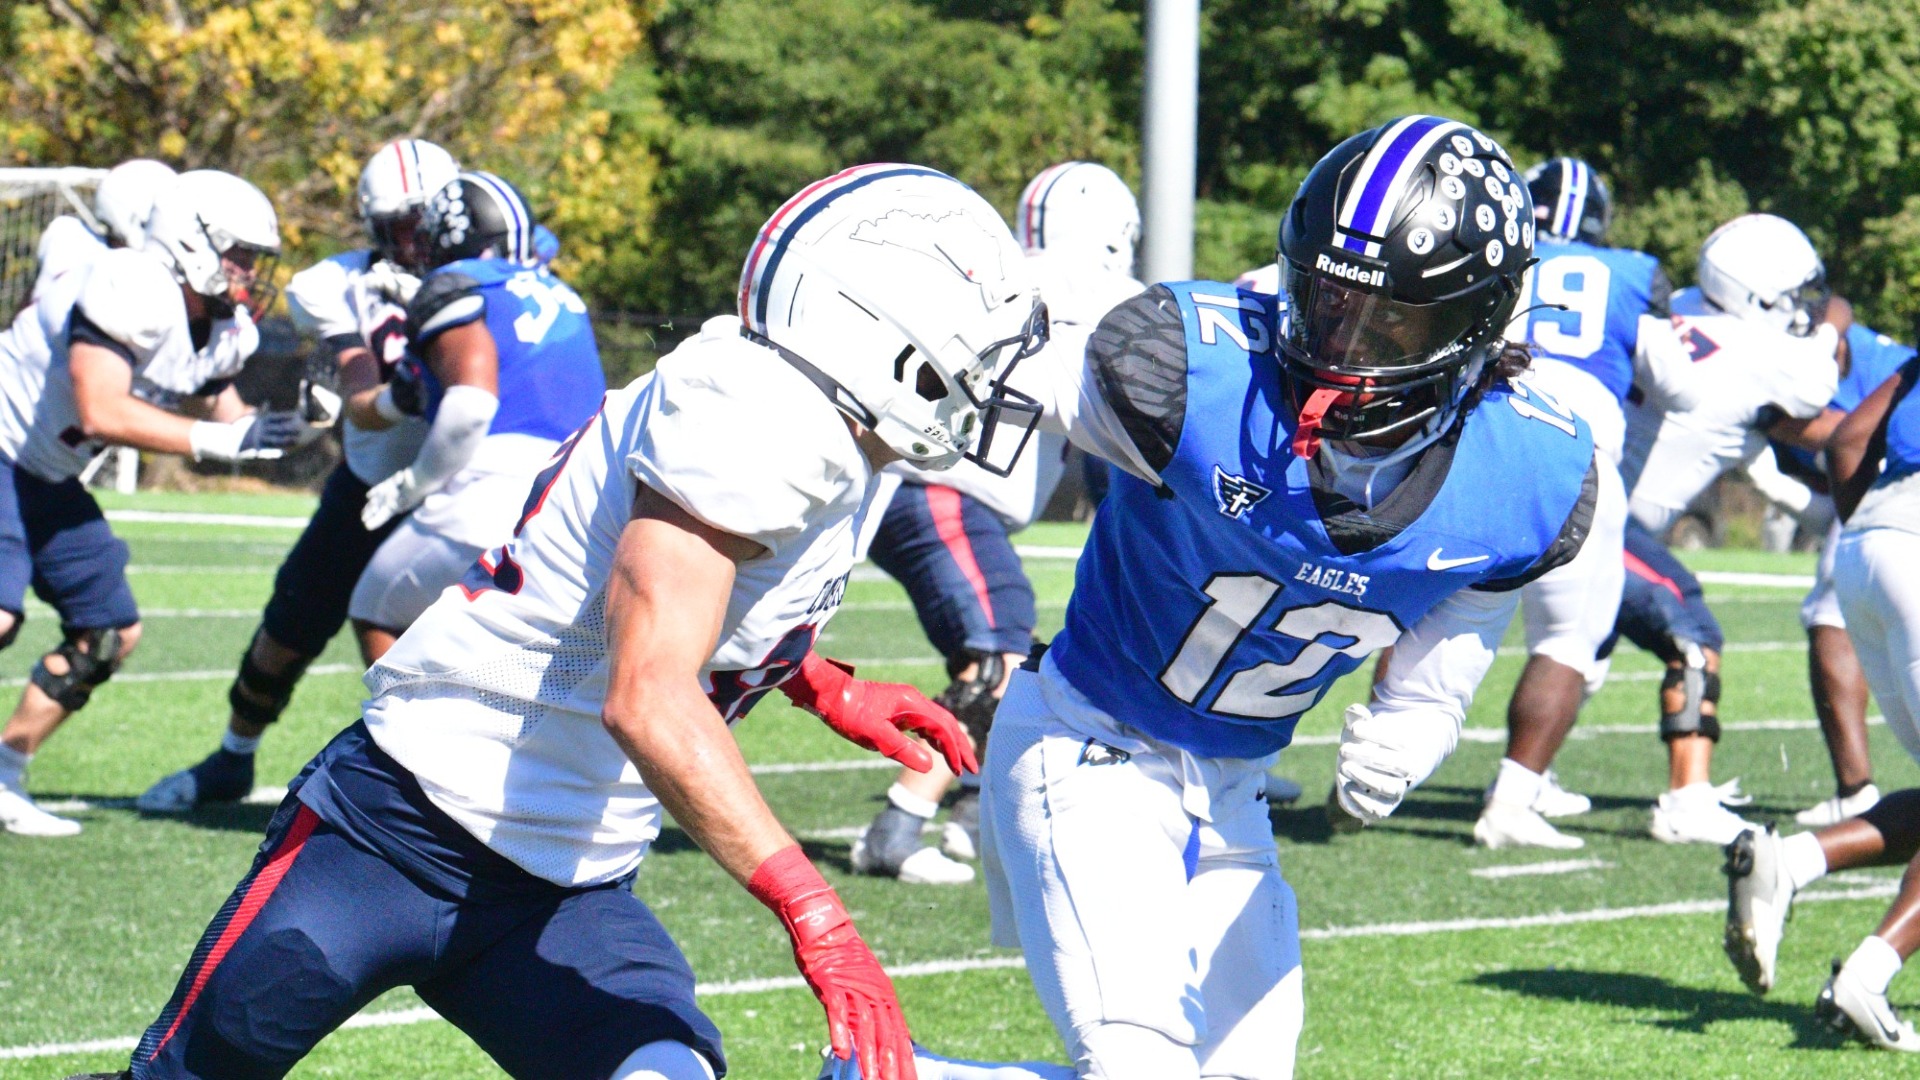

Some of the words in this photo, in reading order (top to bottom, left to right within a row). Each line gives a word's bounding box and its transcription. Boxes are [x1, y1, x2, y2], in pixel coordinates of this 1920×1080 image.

[1315, 253, 1385, 287] Riddell
[1189, 291, 1270, 354] 12
[1333, 409, 1366, 422] Ridell
[1293, 561, 1371, 597] EAGLES
[1157, 570, 1406, 721] 12
